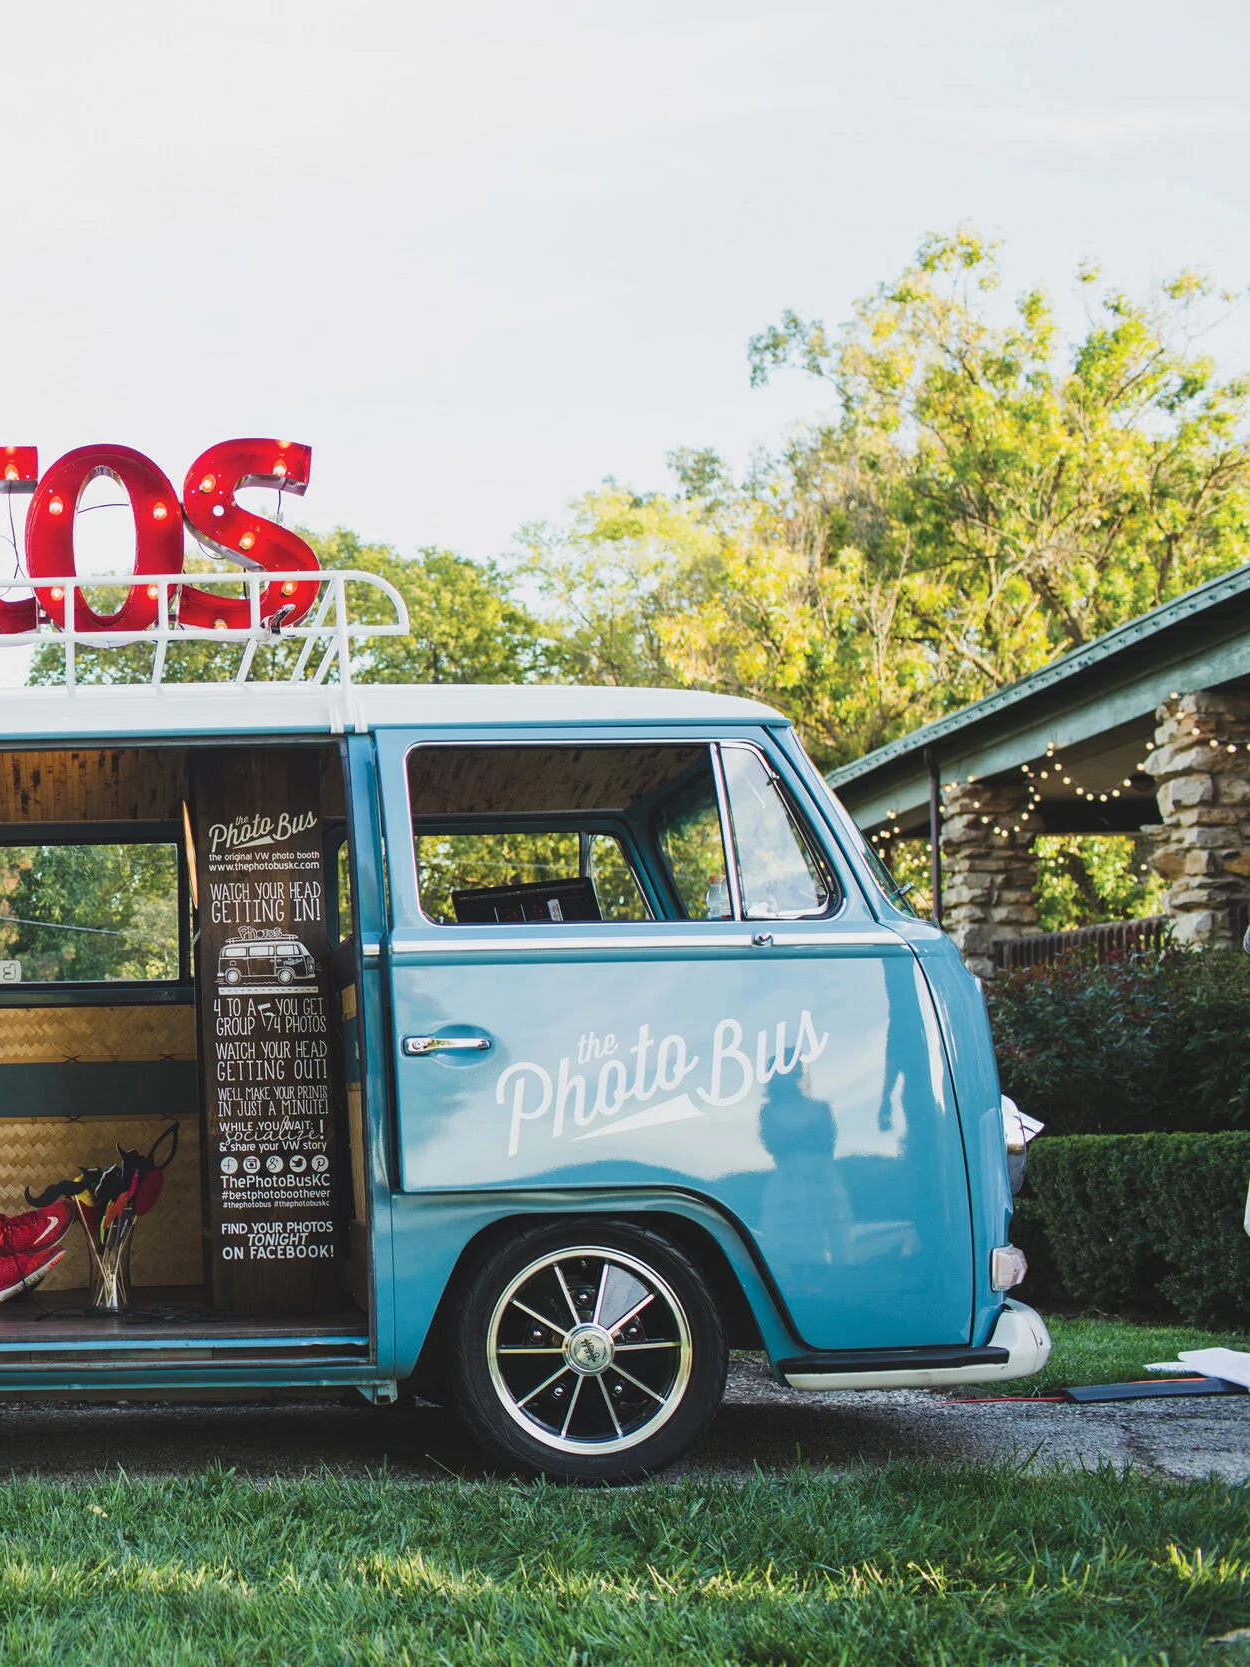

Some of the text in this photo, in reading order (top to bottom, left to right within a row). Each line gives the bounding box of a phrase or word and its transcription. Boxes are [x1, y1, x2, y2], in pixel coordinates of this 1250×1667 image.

[235, 815, 249, 826] the
[209, 811, 318, 853] Photo Bus
[209, 851, 319, 862] the original VW photo booth
[209, 861, 319, 872] www.thephotobuskc.com
[210, 881, 321, 900] WATCH YOUR HEAD
[211, 898, 321, 923] GETTING IN!
[214, 998, 257, 1017] 4 TO A
[275, 998, 324, 1016] YOU GET
[216, 1016, 255, 1036] GROUP
[274, 1016, 327, 1034] 4 PHOTOS
[215, 1040, 327, 1060] WATCH YOUR HEAD
[577, 1031, 618, 1064] the
[217, 1058, 327, 1081] GETTING OUT!
[496, 1010, 829, 1158] Photo Bus
[245, 1086, 270, 1100] MAKE
[273, 1086, 295, 1100] YOUR
[297, 1085, 328, 1099] PRINTS
[217, 1099, 329, 1117] IN JUST A MINUTE!
[219, 1121, 253, 1131] WHILE
[258, 1121, 279, 1131] YOU
[219, 1141, 327, 1153] & share your VW story
[220, 1173, 330, 1188] ThePhotoBusKC
[221, 1189, 330, 1201] #bestphotoboothever
[223, 1200, 330, 1209] #thephotobus #thephotobuskc
[221, 1221, 333, 1234] FIND YOUR PHOTOS
[247, 1233, 309, 1246] TONIGHT
[222, 1245, 334, 1259] ON FACEBOOK!
